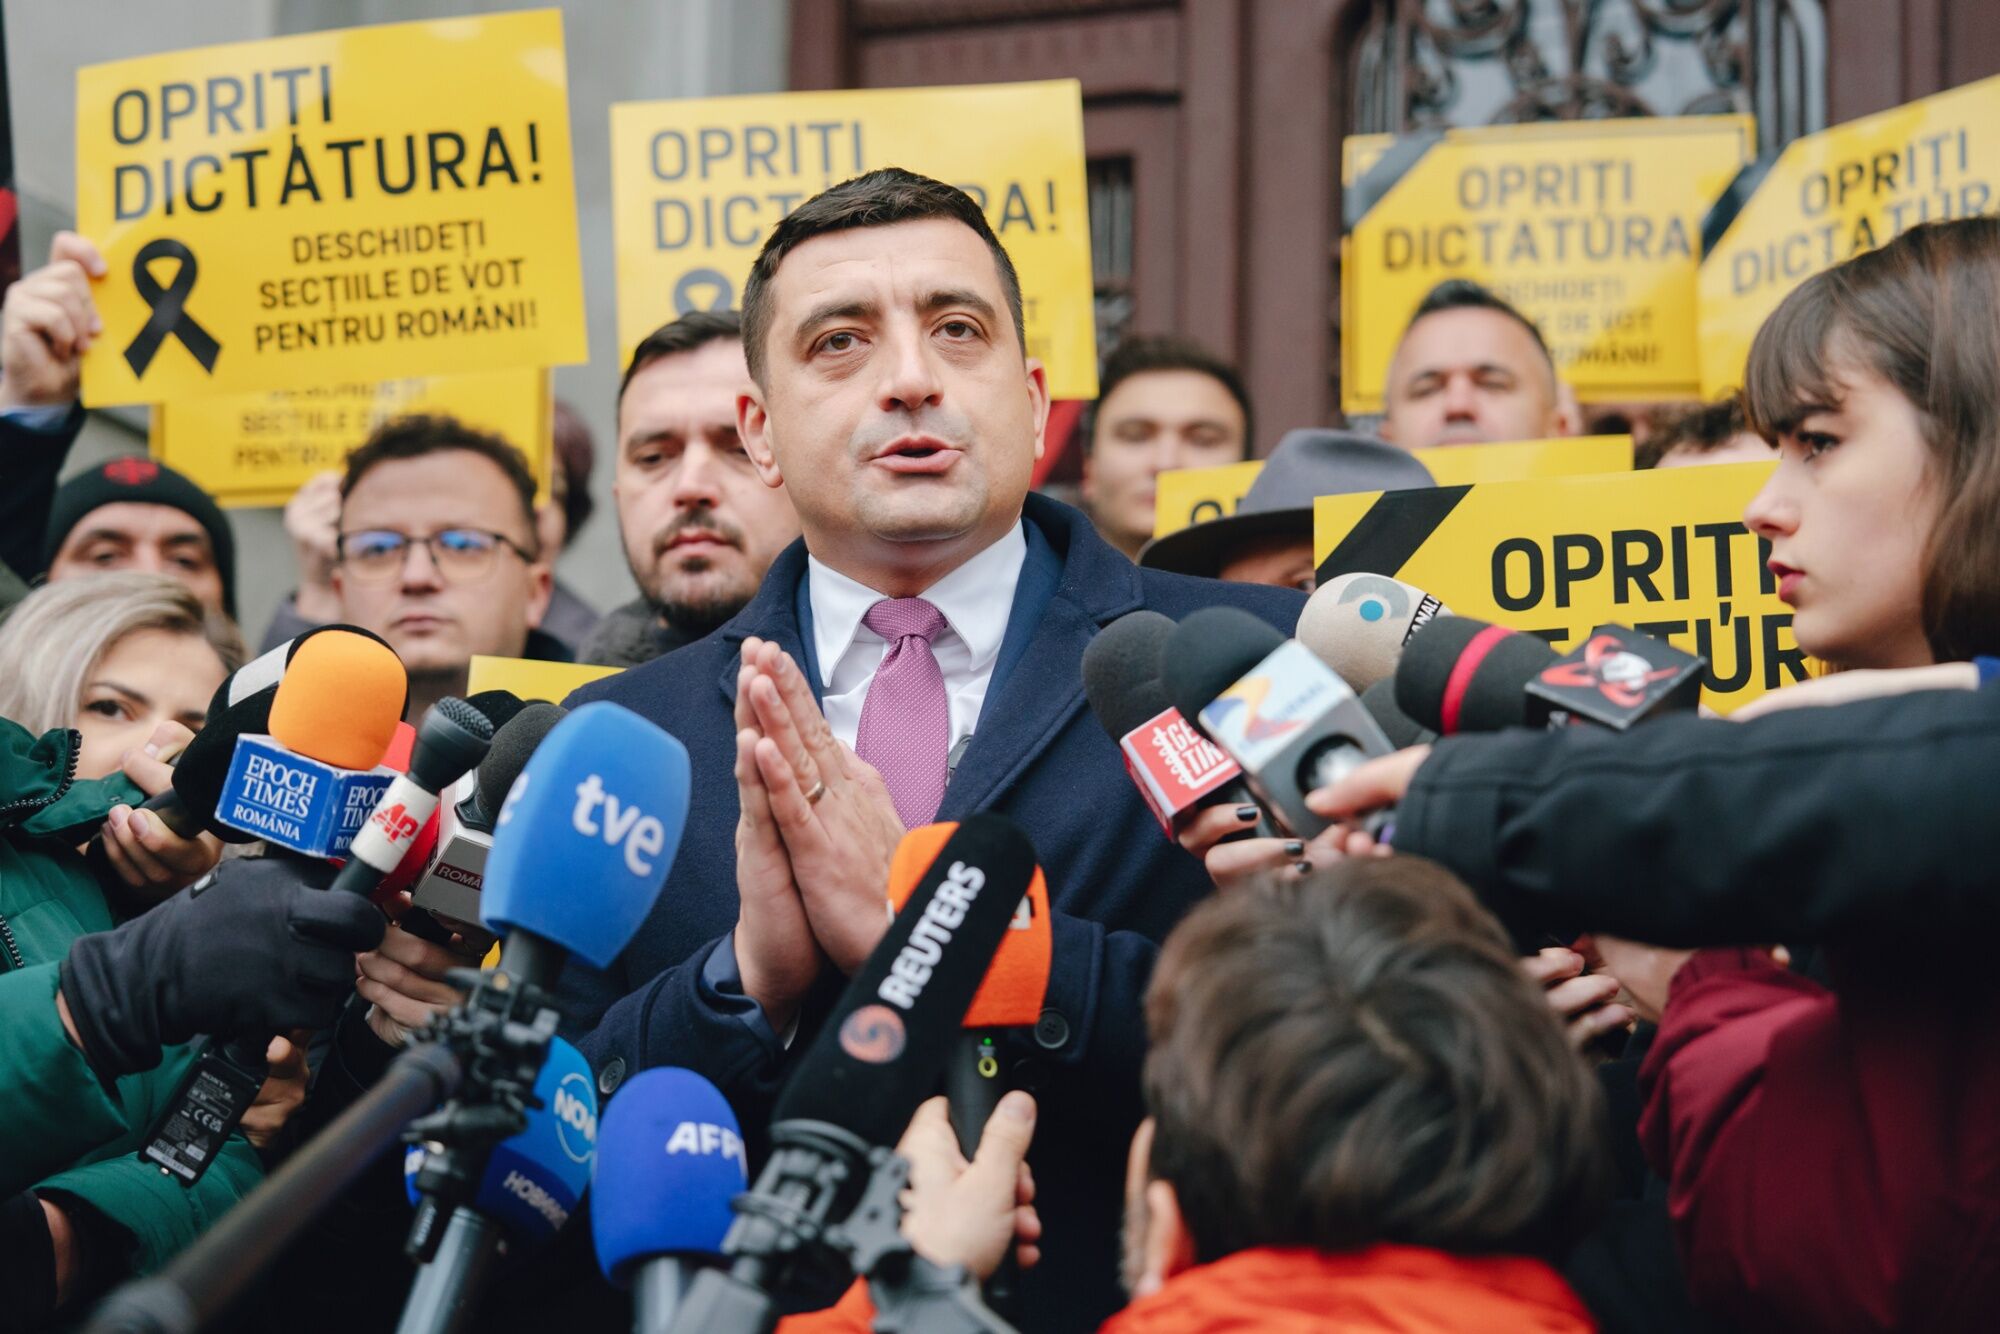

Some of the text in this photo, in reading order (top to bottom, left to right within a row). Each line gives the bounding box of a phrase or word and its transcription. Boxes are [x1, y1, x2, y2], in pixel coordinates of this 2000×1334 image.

[114, 123, 543, 222] DICTATURA!
[292, 220, 486, 265] DESCHIDEȚI
[259, 258, 525, 312] SECȚIILE DE VOT
[255, 300, 538, 352] PENTRU ROMÂNI!
[242, 775, 312, 818] TIMES
[246, 753, 319, 799] EPOCH
[346, 785, 387, 807] EPOC
[233, 803, 302, 842] ROMÂNIA
[342, 806, 373, 829] TIM
[571, 773, 665, 877] tve
[877, 859, 987, 1010] REUTERS
[665, 1121, 744, 1160] AFP
